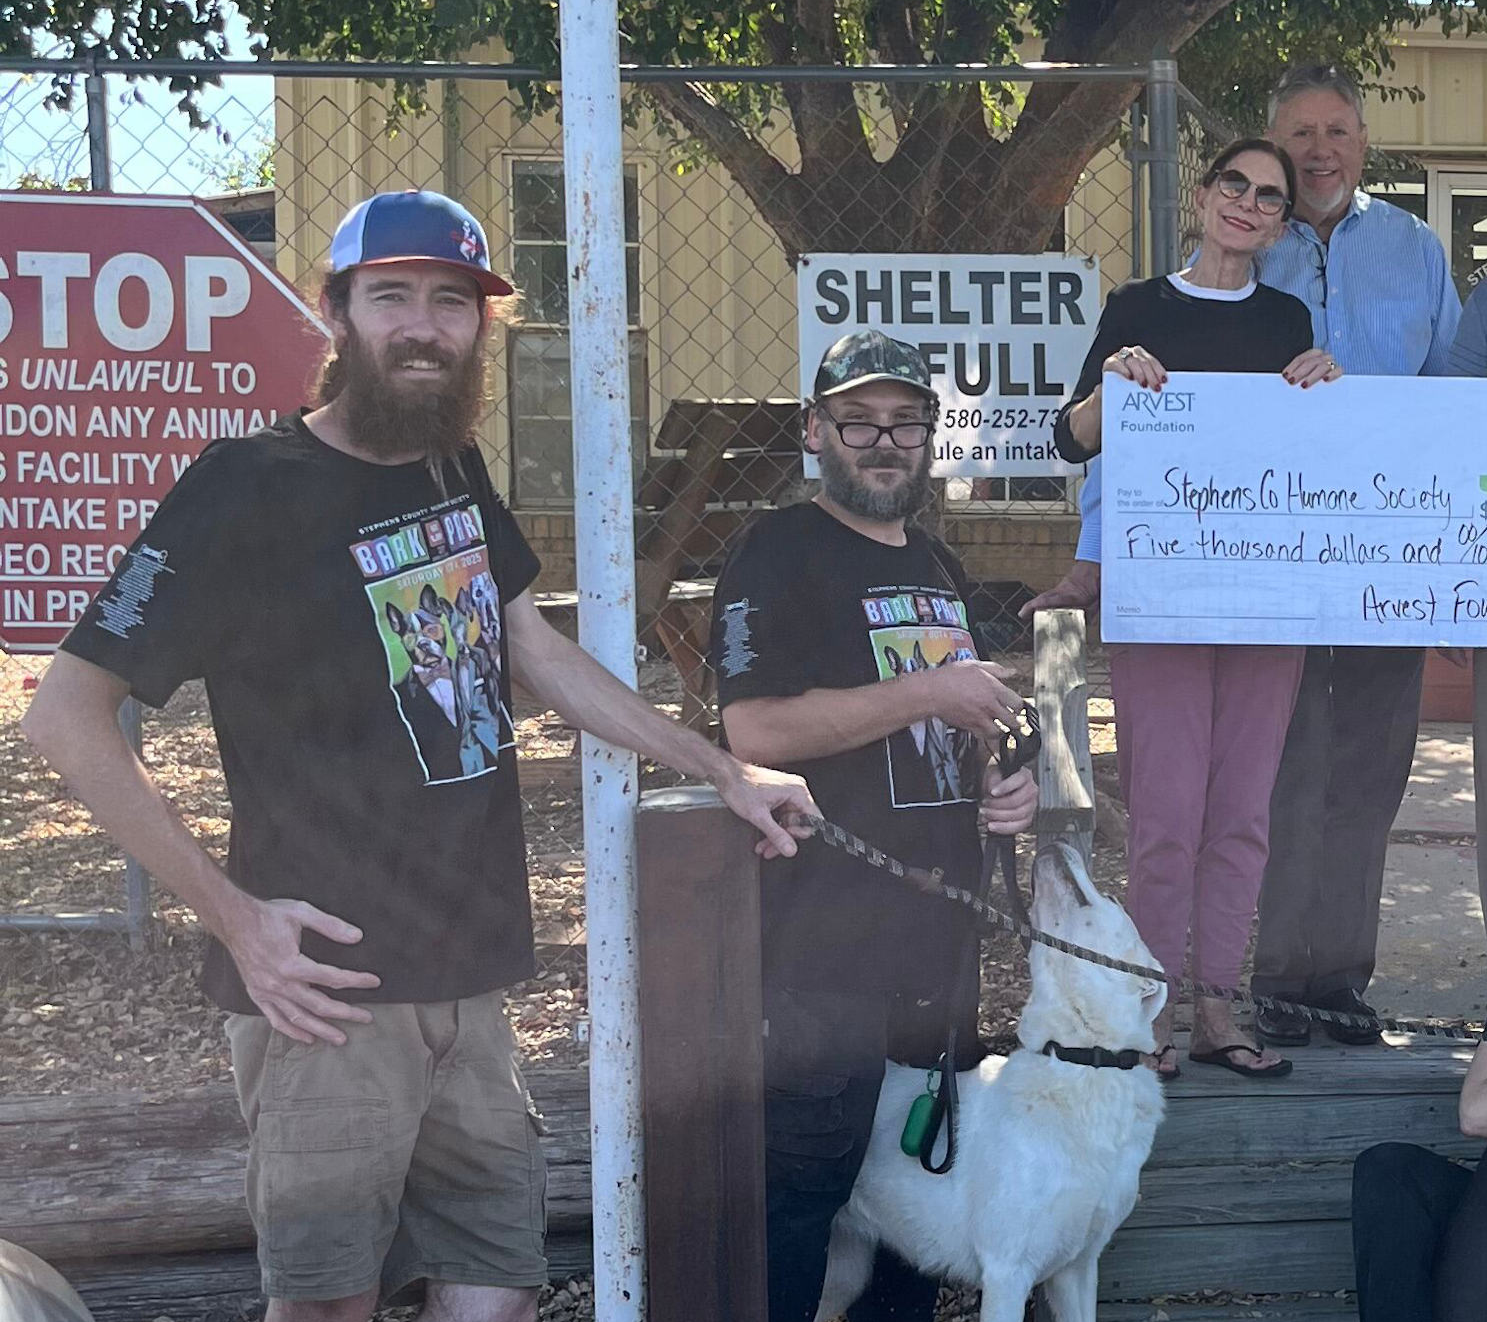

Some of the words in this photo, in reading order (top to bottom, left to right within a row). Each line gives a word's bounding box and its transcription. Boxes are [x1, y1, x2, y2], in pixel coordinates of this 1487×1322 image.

[0, 251, 251, 352] TOP
[815, 268, 1086, 325] SHELTER
[21, 358, 203, 393] UNLAWFUL
[211, 362, 256, 395] TO
[918, 342, 1064, 396] FULL
[0, 404, 77, 437] DON
[86, 405, 155, 438] ANY
[944, 408, 1061, 429] 580-252-73
[1122, 392, 1195, 417] ARVEST
[1121, 420, 1195, 433] Foundation
[935, 440, 964, 460] ule
[972, 445, 997, 460] an
[1005, 440, 1059, 460] intak
[17, 451, 162, 485] FACILITY
[0, 497, 106, 530] NTAKE
[118, 499, 160, 530] PR
[1164, 466, 1256, 523] Stephens
[1288, 471, 1365, 513] Humane
[1373, 472, 1451, 531] Society
[62, 544, 127, 575] REC
[356, 527, 426, 574] BARK
[1126, 524, 1185, 559] Five
[1195, 529, 1305, 563] thousand
[1318, 532, 1390, 565] dollars
[1402, 538, 1442, 565] and
[4, 589, 34, 620] IN
[47, 590, 98, 621] PR
[864, 597, 917, 623] BARK
[1363, 584, 1437, 626] Arvest
